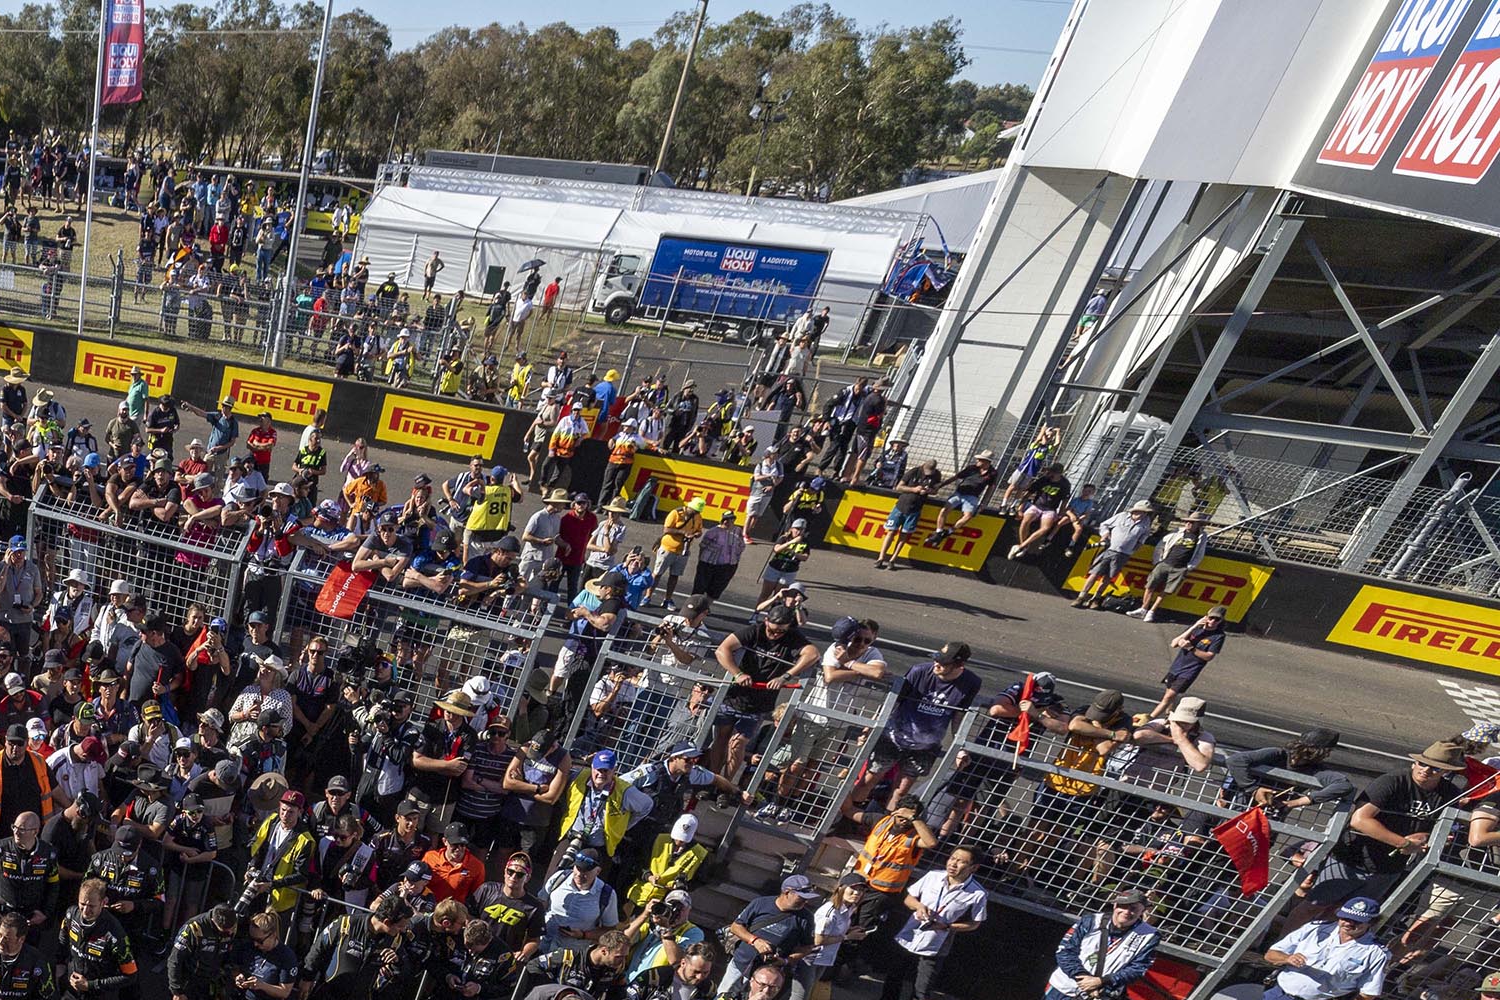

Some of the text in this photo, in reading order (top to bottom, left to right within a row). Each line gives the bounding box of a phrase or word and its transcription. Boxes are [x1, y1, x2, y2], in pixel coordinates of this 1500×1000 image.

[110, 57, 137, 69] MOLY
[1326, 67, 1432, 155] MOLY
[725, 248, 756, 261] LIQUI
[767, 257, 798, 266] ADDITIVES
[722, 258, 753, 271] MOLY
[230, 378, 321, 415] PIRELLI
[388, 406, 490, 447] PIRELLI
[489, 501, 508, 515] 80
[329, 591, 346, 615] Sport
[1352, 602, 1500, 661] PIRELL
[917, 702, 946, 714] Holden
[483, 903, 528, 927] 46
